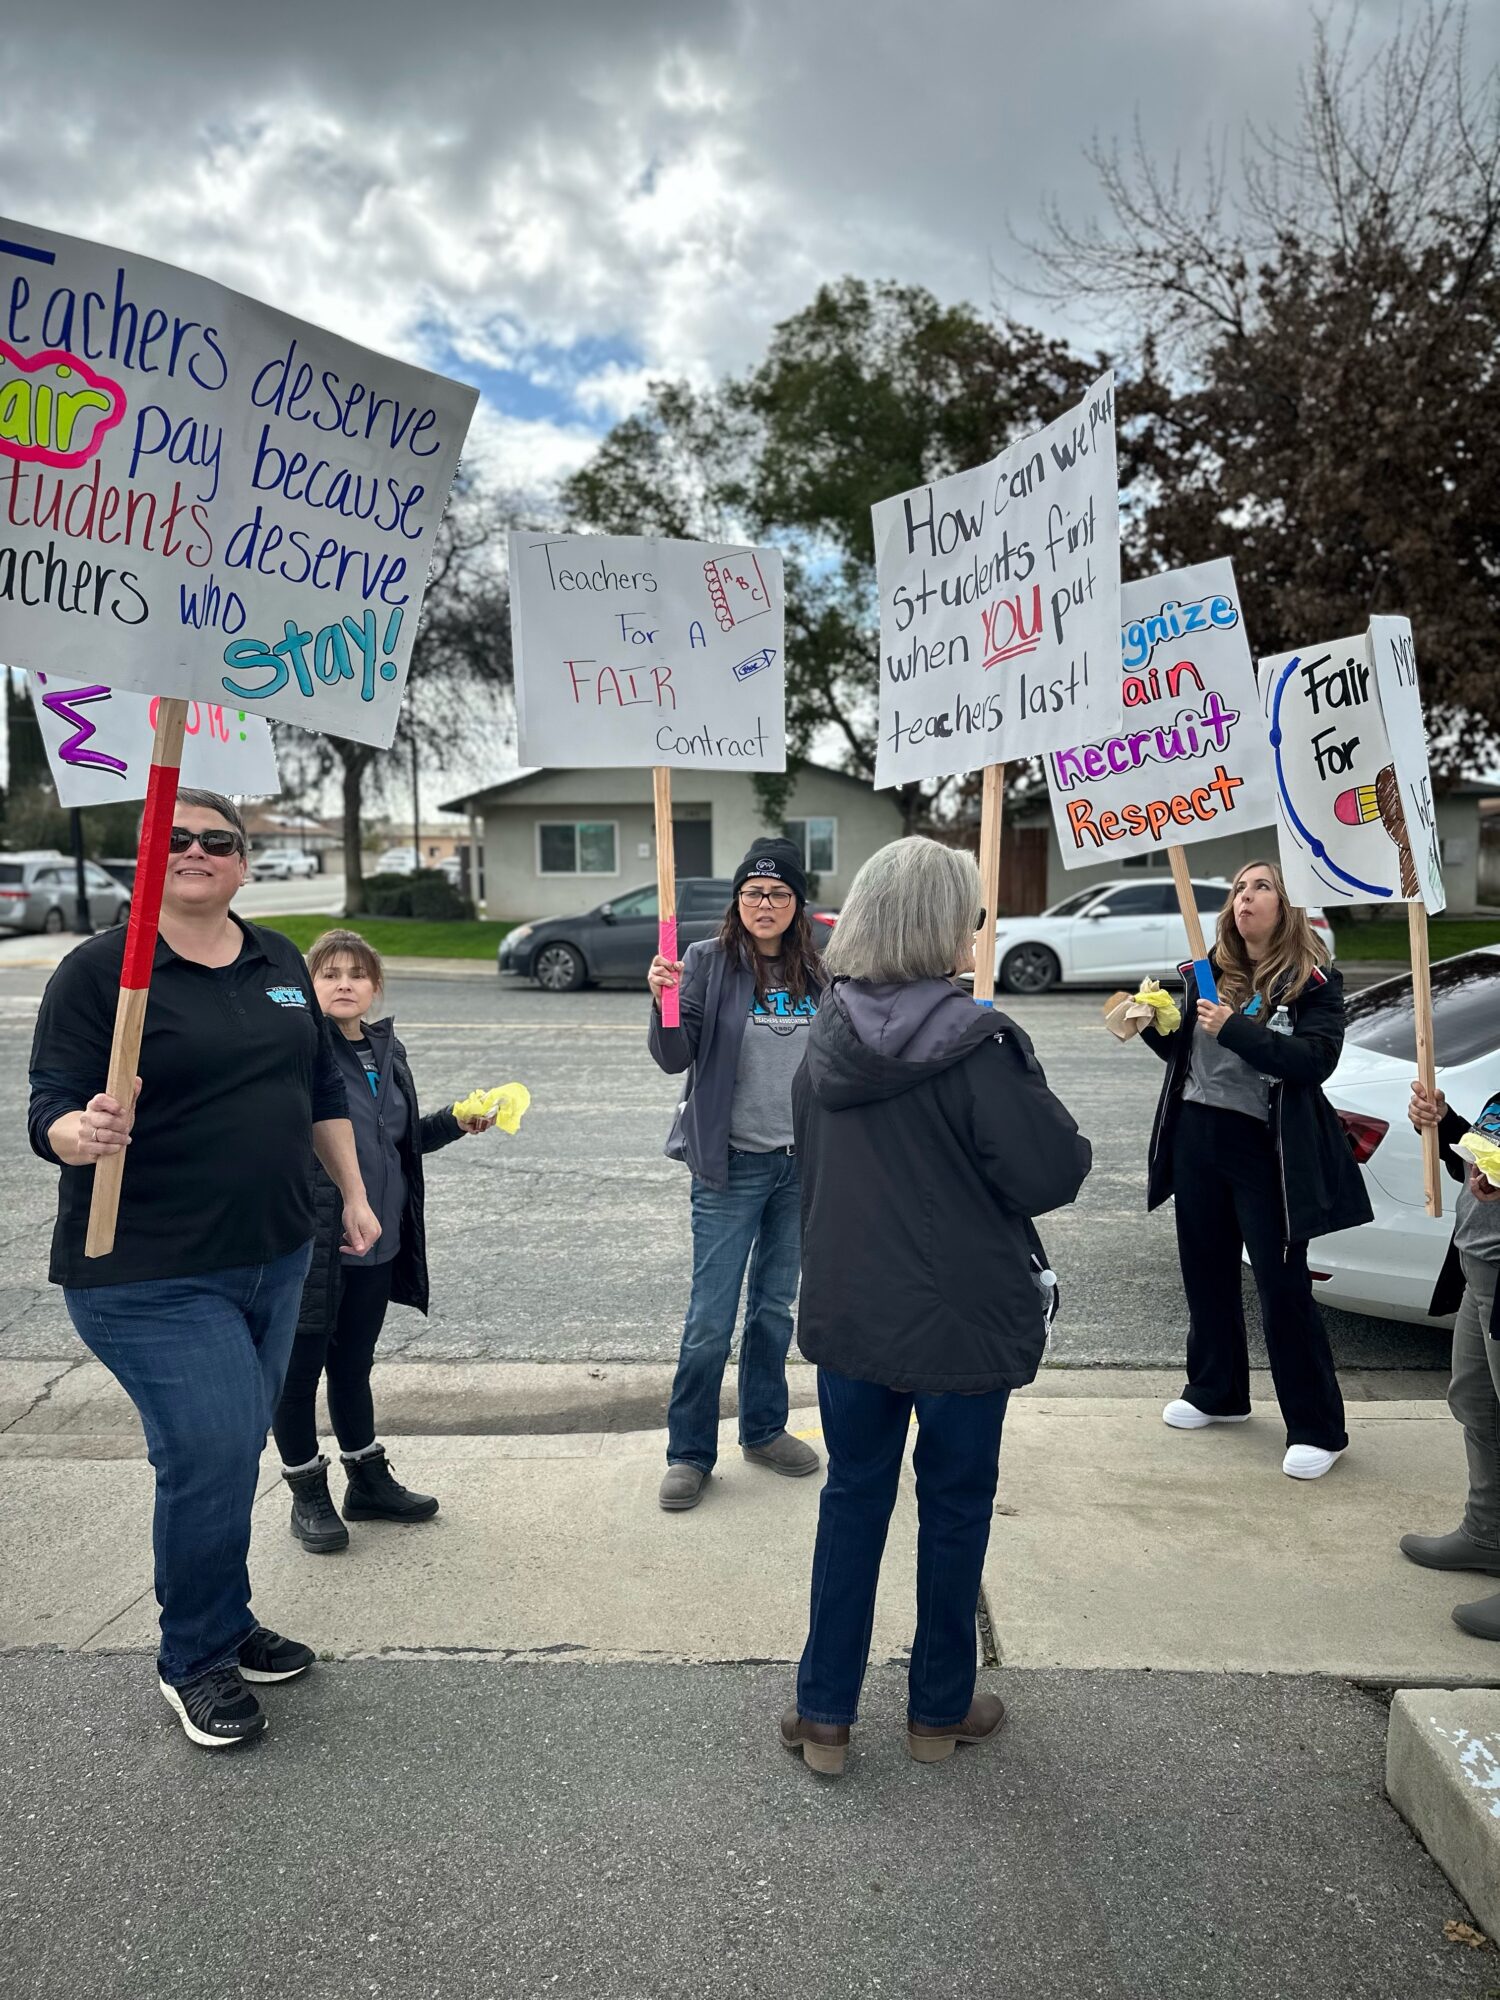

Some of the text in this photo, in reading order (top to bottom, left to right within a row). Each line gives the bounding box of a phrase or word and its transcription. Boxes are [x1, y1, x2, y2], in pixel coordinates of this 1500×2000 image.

[251, 340, 440, 456] deserve
[0, 353, 425, 539] air pay because
[904, 488, 985, 558] How
[1088, 387, 1113, 454] put
[0, 459, 410, 606] tudents deserve
[529, 540, 658, 592] Teachers
[1045, 495, 1097, 572] first
[0, 541, 247, 634] achers who
[887, 558, 1097, 683] when YOU put
[614, 612, 706, 649] For A
[1121, 595, 1239, 672] gnize
[562, 659, 677, 710] FAIR
[887, 650, 1089, 753] teachers last!
[1300, 654, 1370, 714] Fair
[656, 717, 769, 758] Contract
[1310, 726, 1361, 781] For
[1066, 766, 1244, 848] Respect
